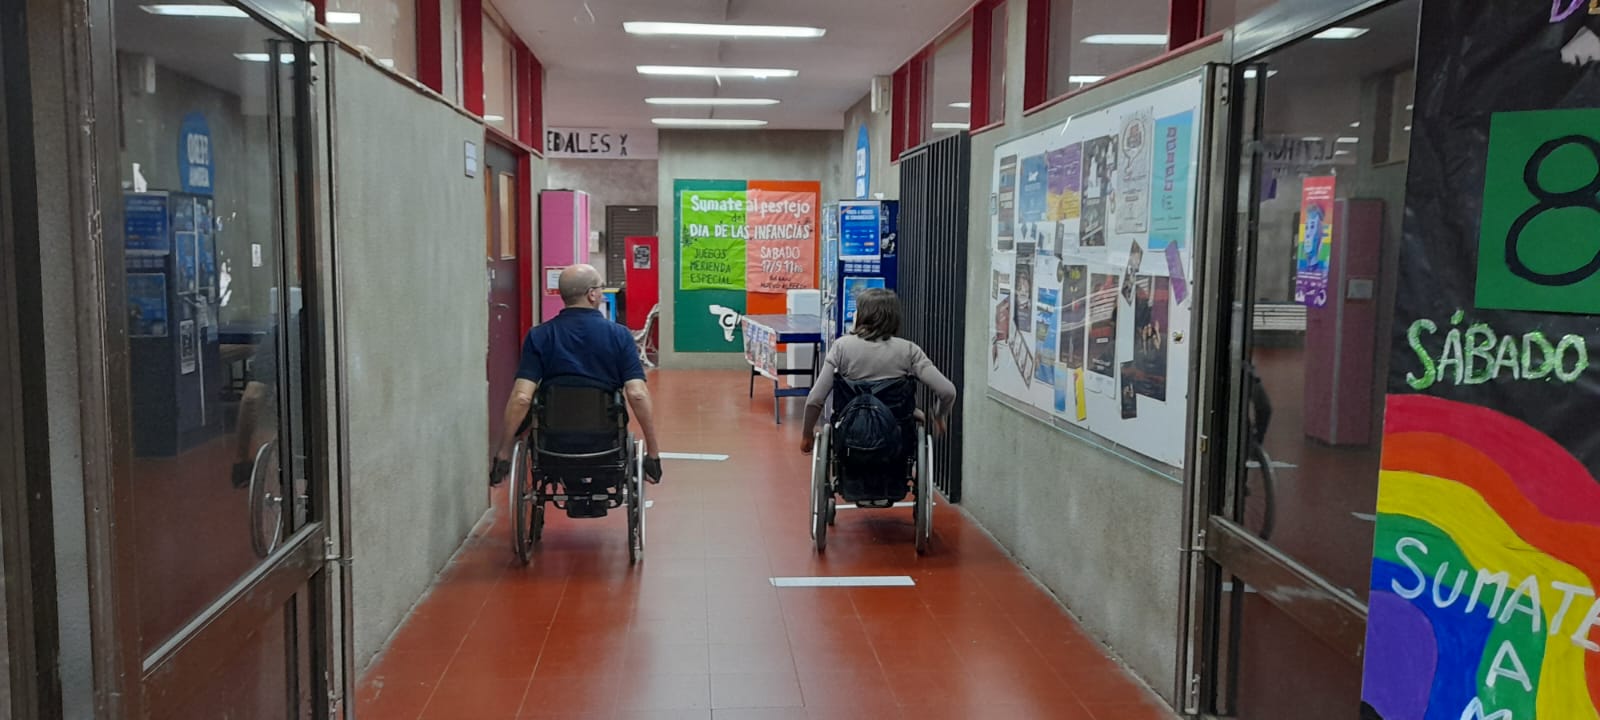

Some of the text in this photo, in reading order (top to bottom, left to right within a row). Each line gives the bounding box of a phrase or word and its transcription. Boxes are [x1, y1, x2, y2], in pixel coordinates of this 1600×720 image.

[690, 194, 810, 218] Sumate al festejo
[689, 224, 810, 239] DIA DE LAS INFANCIAS
[690, 261, 731, 273] MERIENDA
[690, 274, 733, 285] ESPECIAL
[1406, 309, 1589, 390] SÁBADO
[1391, 536, 1600, 653] SUMATE
[1485, 639, 1533, 692] A
